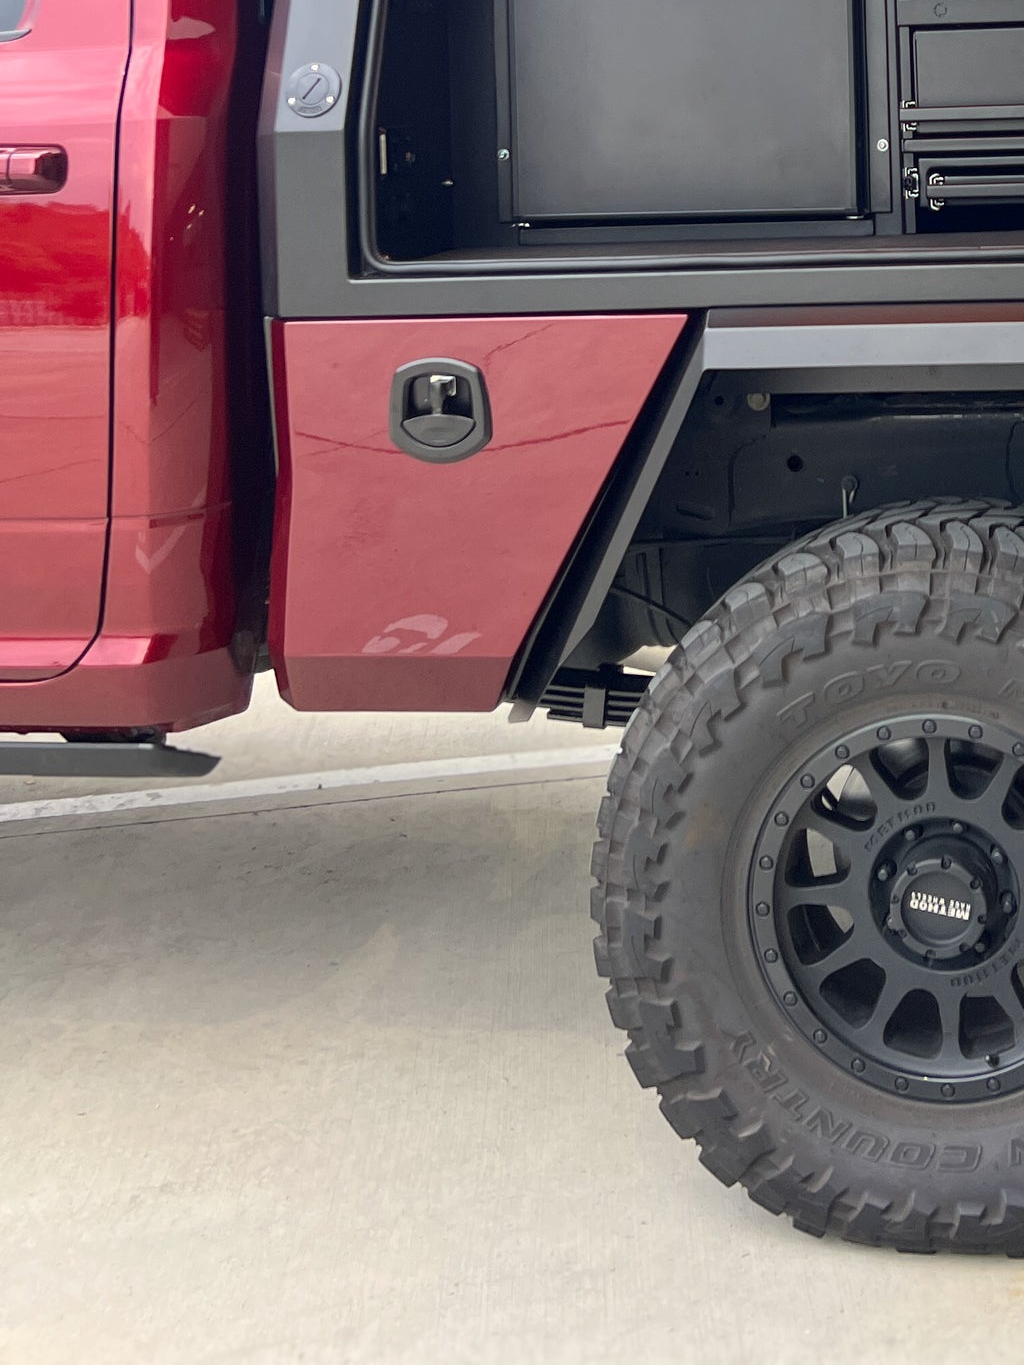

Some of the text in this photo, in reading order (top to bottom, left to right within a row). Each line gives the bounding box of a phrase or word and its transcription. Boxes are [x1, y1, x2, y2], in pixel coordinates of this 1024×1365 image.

[775, 659, 962, 728] TOYO
[909, 897, 971, 921] METHOD
[720, 1026, 984, 1173] COUNTRY
